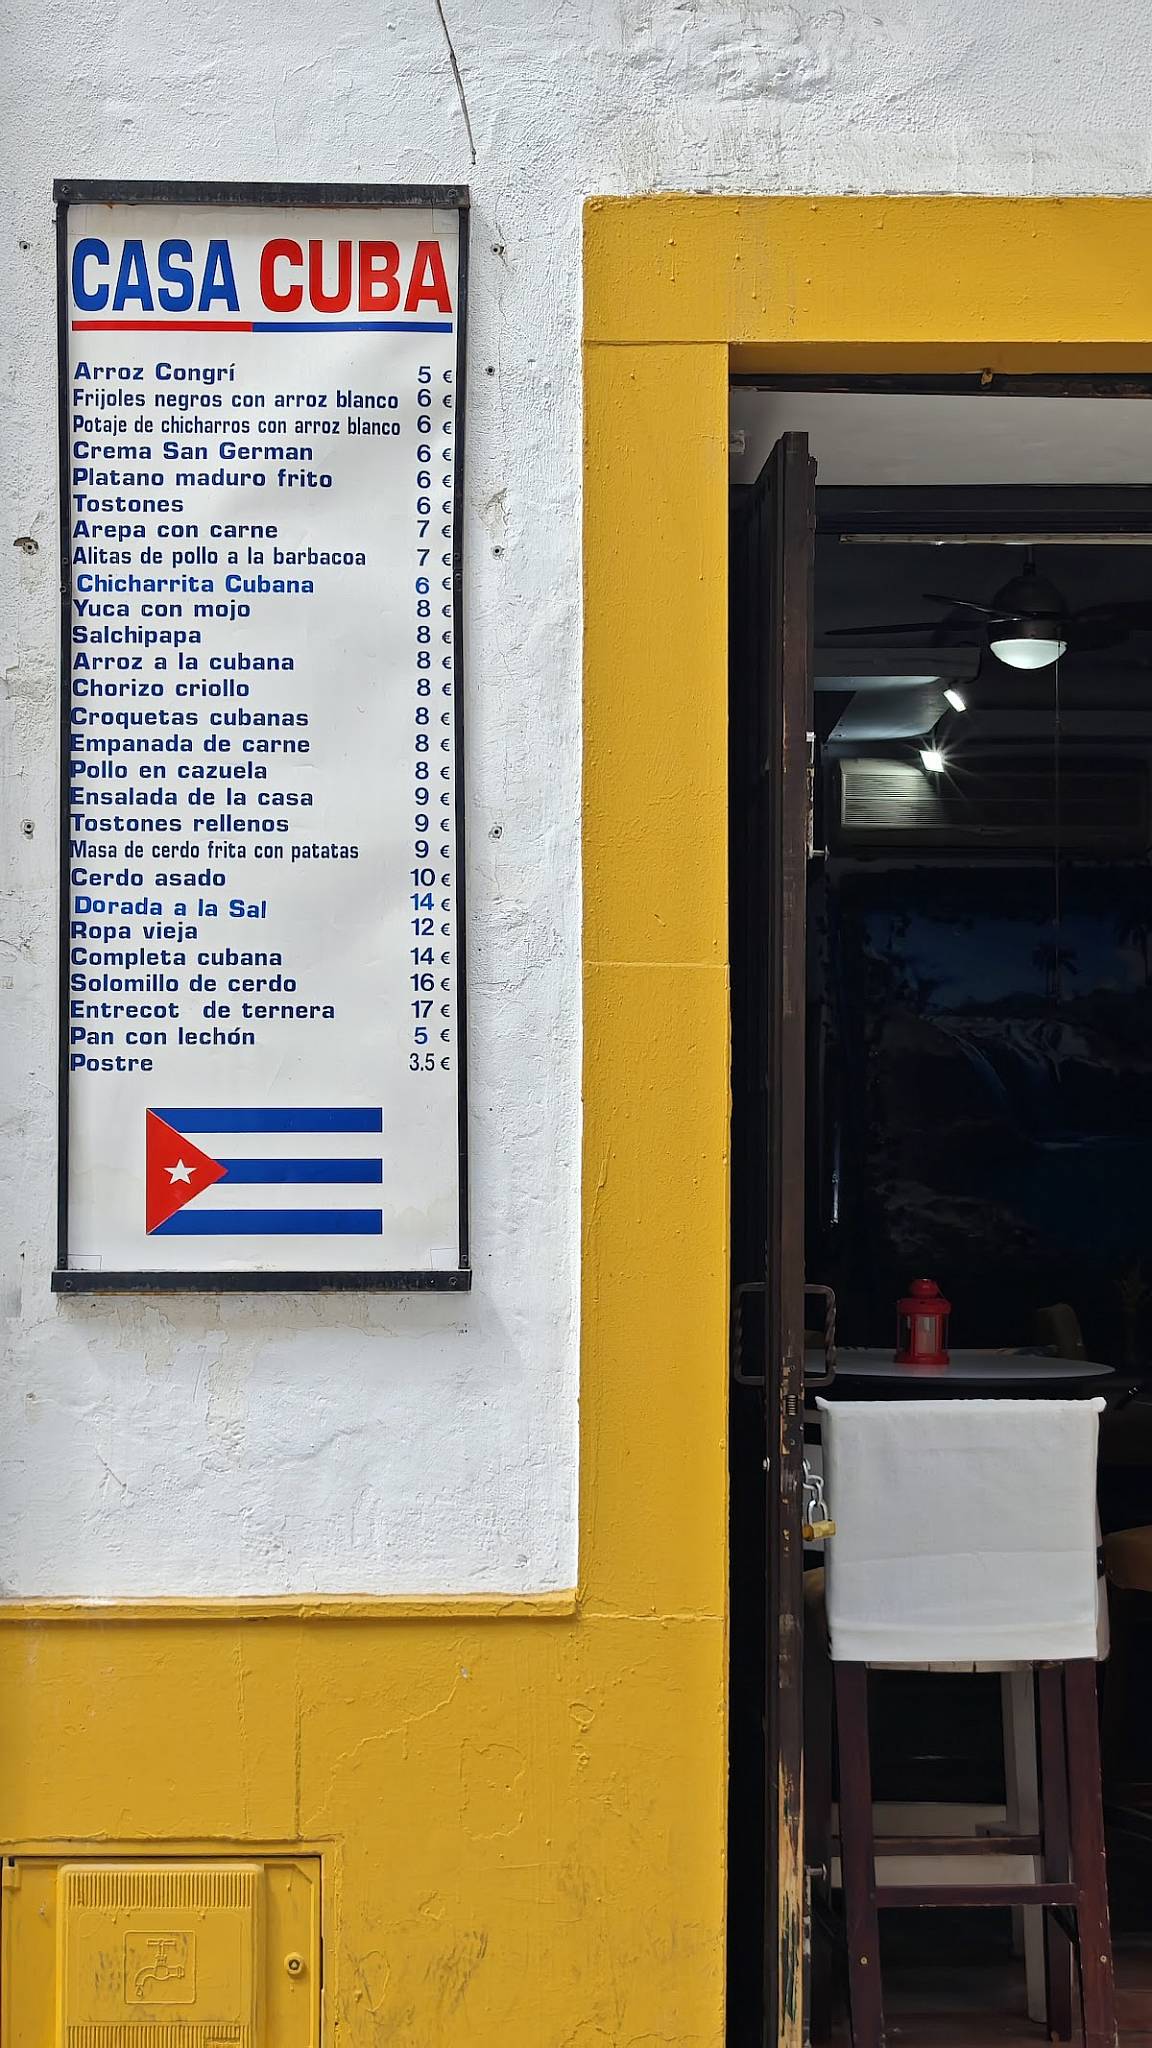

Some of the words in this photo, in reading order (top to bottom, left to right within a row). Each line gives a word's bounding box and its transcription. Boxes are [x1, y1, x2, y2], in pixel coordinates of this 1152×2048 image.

[72, 237, 240, 312] CASA
[259, 238, 453, 313] CUBA
[73, 361, 144, 381] Arroz
[155, 362, 235, 386] Congrí
[417, 365, 432, 384] 5
[442, 369, 453, 384] €
[73, 388, 146, 410] Frijoles
[154, 394, 222, 412] negros
[231, 394, 265, 408] con
[274, 394, 328, 408] arroz
[336, 389, 399, 409] blanco
[417, 388, 432, 408] 6
[442, 394, 453, 409] €
[73, 414, 127, 437] Potaje
[134, 414, 154, 433] de
[161, 415, 250, 434] chicharros
[258, 420, 287, 434] con
[294, 420, 340, 435] arroz
[347, 416, 401, 436] blanco
[416, 414, 432, 434] 6
[442, 421, 452, 435] €
[73, 440, 152, 460] Crema
[163, 441, 208, 460] San
[219, 441, 313, 461] German
[416, 444, 432, 463] 6
[442, 447, 452, 462] €
[72, 467, 164, 486] Platano
[175, 467, 266, 487] maduro
[277, 468, 333, 488] frito
[416, 470, 431, 489] 6
[442, 474, 452, 488] €
[72, 493, 184, 513] Tostones
[416, 496, 431, 515] 6
[441, 500, 452, 515] €
[72, 519, 146, 543] Arepa
[157, 524, 199, 538] con
[210, 524, 278, 539] carne
[416, 519, 430, 538] 7
[441, 524, 452, 539] €
[72, 546, 132, 565] Alitas
[140, 546, 163, 565] de
[172, 545, 218, 569] pollo
[227, 551, 238, 565] a
[247, 546, 264, 565] la
[273, 546, 366, 566] barbacoa
[416, 548, 430, 567] 7
[441, 552, 452, 567] €
[76, 573, 214, 593] Chicharrita
[225, 574, 314, 594] Cubana
[415, 576, 430, 595] 6
[441, 576, 452, 591] €
[72, 598, 130, 617] Yuca
[141, 604, 182, 617] con
[193, 599, 251, 621] mojo
[416, 599, 431, 618] 8
[441, 604, 452, 618] €
[72, 625, 201, 648] Salchipapa
[416, 625, 431, 644] 8
[441, 630, 452, 645] €
[72, 652, 143, 671] Arroz
[154, 656, 167, 670] a
[178, 652, 198, 670] la
[209, 652, 294, 671] cubana
[416, 650, 431, 670] 8
[441, 656, 452, 670] €
[72, 678, 164, 697] Chorizo
[175, 678, 250, 697] criollo
[416, 678, 431, 697] 8
[441, 682, 452, 697] €
[70, 706, 199, 730] Croquetas
[210, 707, 309, 727] cubanas
[415, 706, 430, 726] 8
[440, 712, 450, 726] €
[69, 733, 193, 756] Empanada
[203, 733, 231, 753] de
[242, 739, 310, 753] carne
[415, 733, 430, 753] 8
[440, 738, 450, 752] €
[69, 759, 128, 779] Pollo
[139, 765, 166, 779] en
[177, 760, 267, 780] cazuela
[415, 761, 429, 780] 8
[439, 766, 450, 780] €
[69, 786, 178, 806] Ensalada
[188, 787, 215, 806] de
[226, 787, 246, 806] la
[257, 792, 313, 806] casa
[414, 787, 429, 806] 9
[439, 792, 450, 806] €
[68, 813, 182, 832] Tostones
[193, 813, 289, 833] rellenos
[414, 813, 429, 833] 9
[440, 818, 450, 832] €
[68, 839, 117, 859] Masa
[124, 840, 144, 858] de
[151, 840, 200, 859] cerdo
[207, 840, 246, 859] frita
[254, 845, 283, 859] con
[291, 843, 359, 863] patatas
[414, 839, 429, 859] 9
[440, 844, 450, 859] €
[71, 867, 144, 887] Cerdo
[155, 868, 226, 887] asado
[410, 868, 436, 887] 10
[441, 873, 451, 887] €
[74, 895, 163, 916] Dorada
[174, 902, 187, 917] a
[198, 898, 218, 917] la
[229, 899, 267, 919] Sal
[409, 892, 435, 911] 14
[440, 898, 451, 912] €
[70, 920, 131, 944] Ropa
[142, 921, 198, 943] vieja
[410, 917, 435, 936] 12
[440, 922, 451, 937] €
[70, 946, 186, 970] Completa
[197, 947, 282, 966] cubana
[410, 947, 435, 966] 14
[440, 951, 451, 965] €
[70, 973, 179, 992] Solomillo
[189, 973, 217, 992] de
[228, 973, 297, 992] cerdo
[409, 972, 435, 992] 16
[440, 977, 451, 992] €
[70, 999, 180, 1019] Entrecot
[203, 1000, 231, 1019] de
[241, 1002, 335, 1019] ternera
[410, 1000, 434, 1019] 17
[440, 1003, 451, 1018] €
[70, 1026, 114, 1045] Pan
[125, 1031, 167, 1046] con
[178, 1026, 255, 1046] lechón
[414, 1026, 428, 1045] 5
[439, 1028, 450, 1043] €
[70, 1052, 153, 1072] Postre
[409, 1052, 435, 1072] 3.5
[440, 1056, 450, 1071] €
